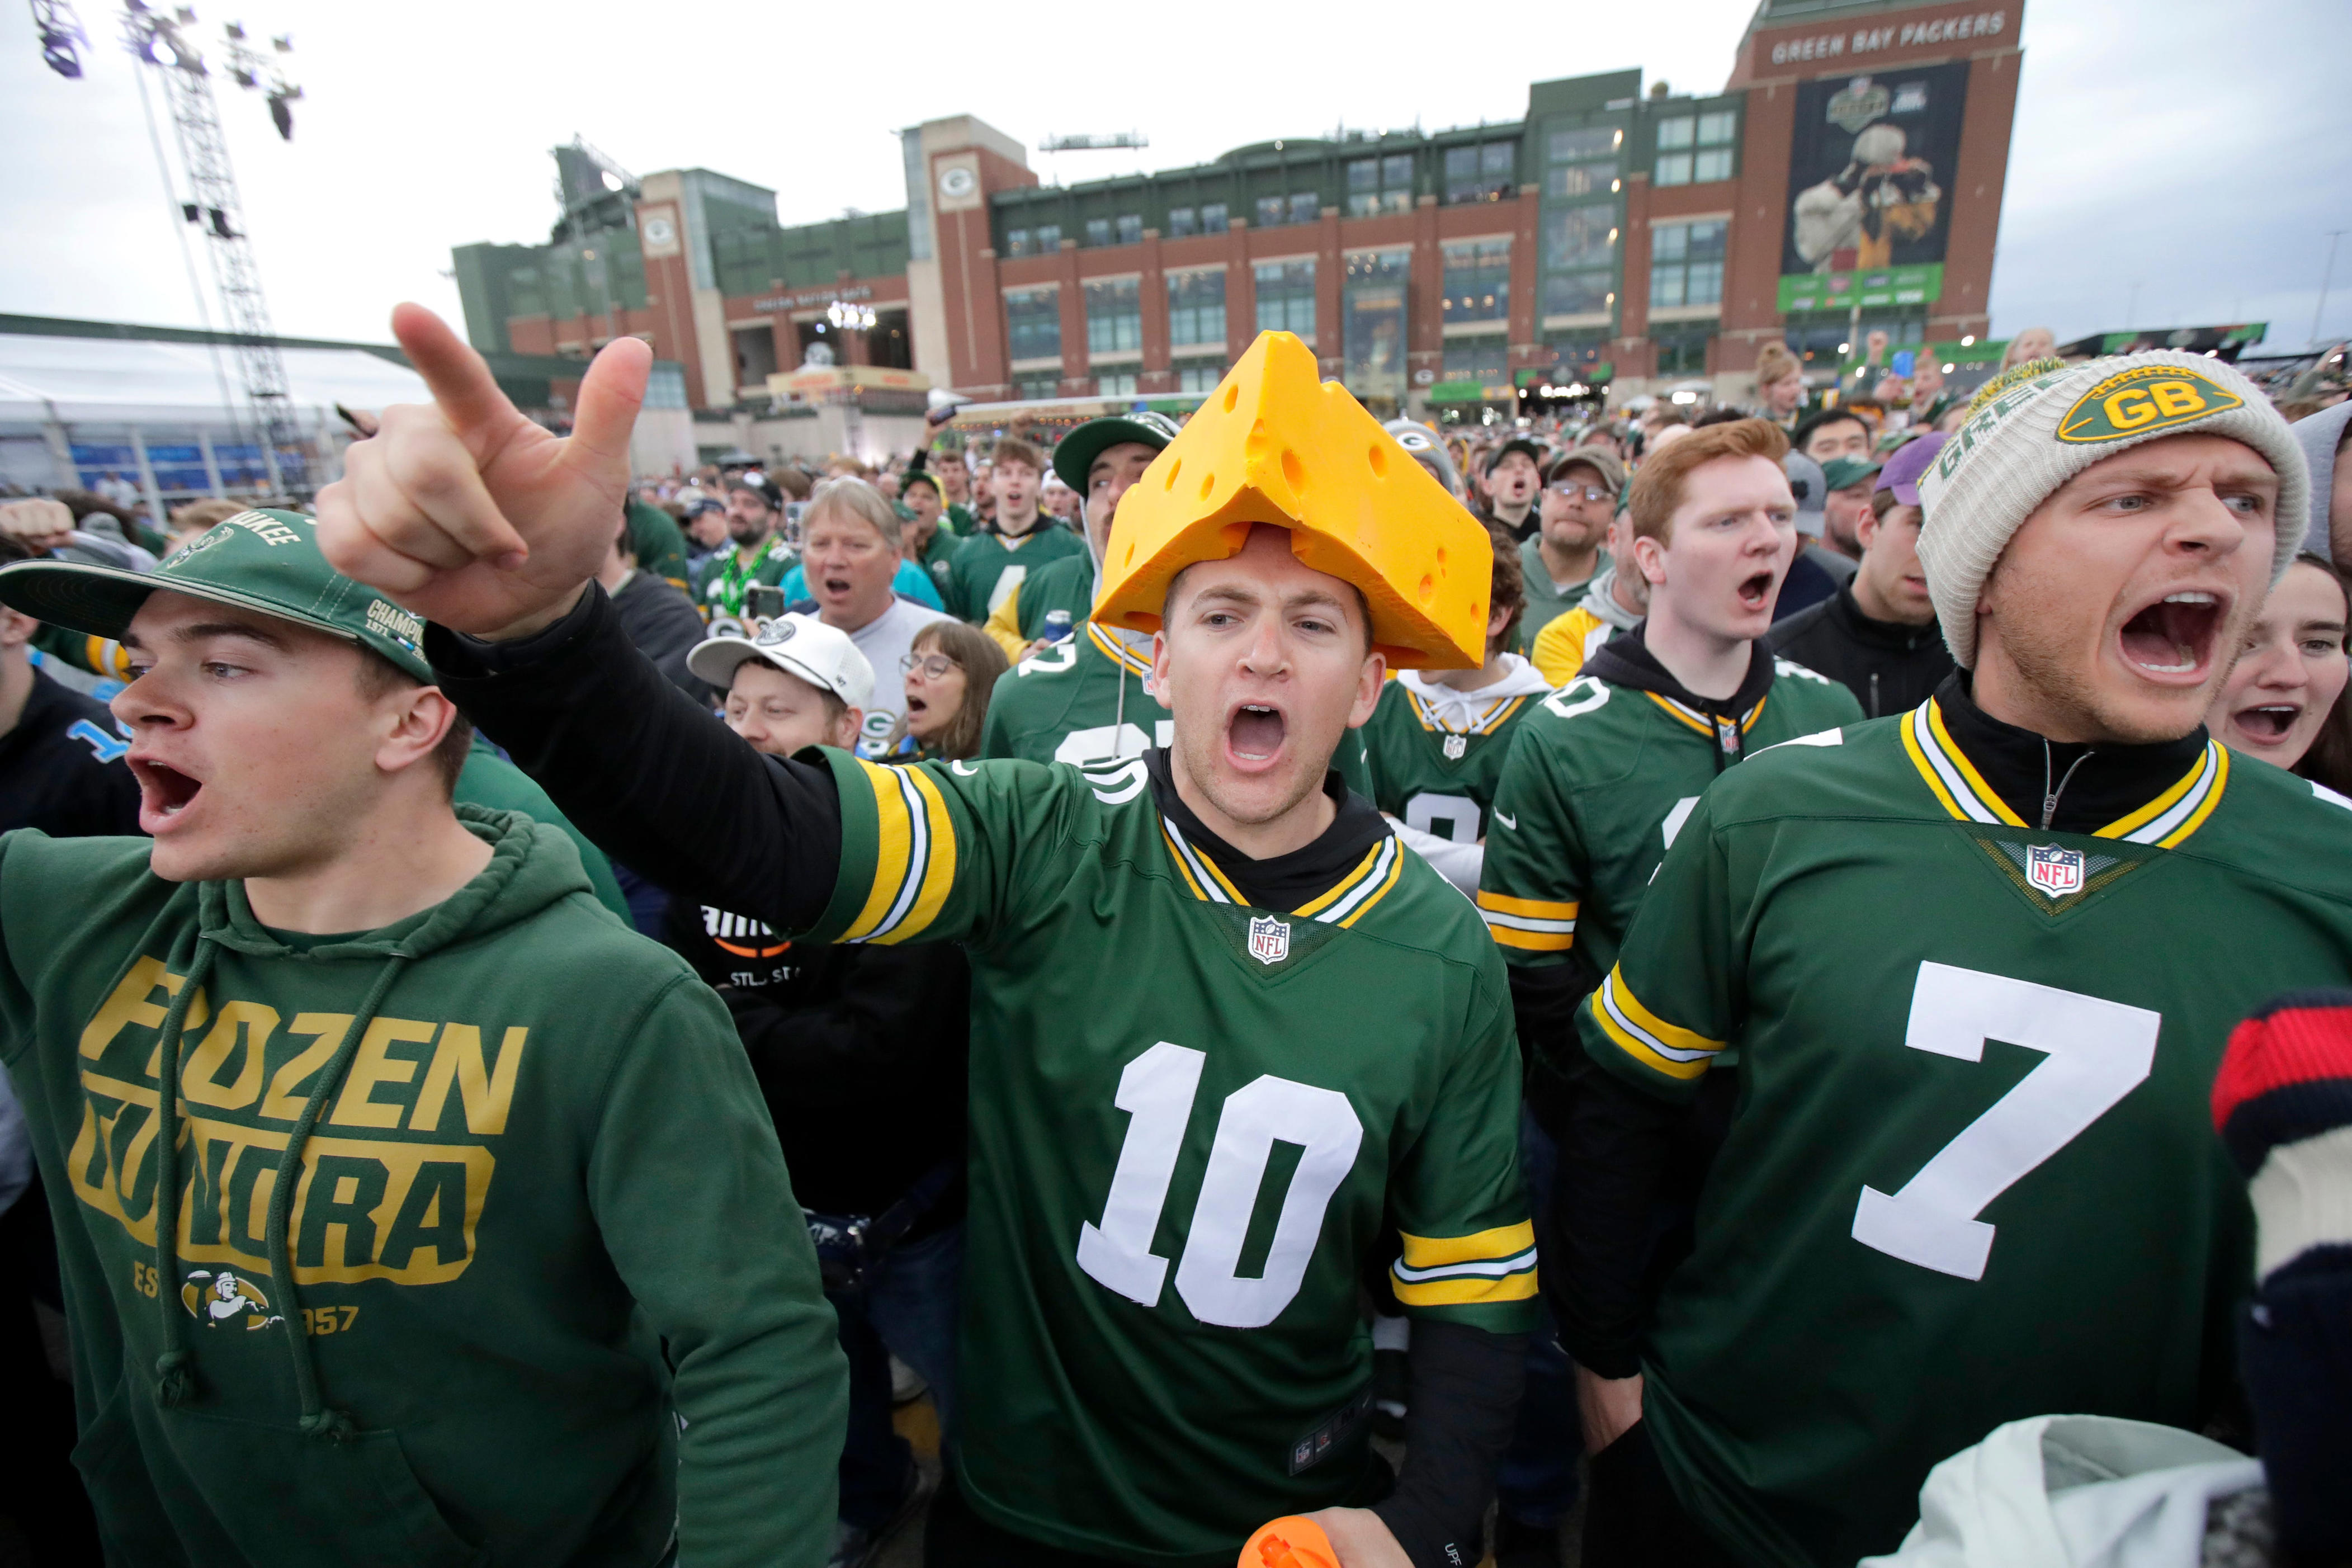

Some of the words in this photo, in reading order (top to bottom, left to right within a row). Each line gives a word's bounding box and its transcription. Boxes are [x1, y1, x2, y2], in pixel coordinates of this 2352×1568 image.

[1772, 35, 1845, 65] GREEN
[1852, 25, 1896, 54] BAY
[1900, 10, 2006, 47] PACKERS
[2103, 380, 2207, 430] GB
[365, 618, 389, 637] 1971
[2036, 862, 2075, 886] NFL
[1255, 935, 1282, 956] NFL
[78, 955, 529, 1136] FROZEN
[1852, 960, 2161, 1282] 7
[82, 1088, 469, 1271] TUNDRA
[1076, 1040, 1364, 1328] 10
[134, 1260, 158, 1299] ES
[1444, 1542, 1462, 1566] UPF
